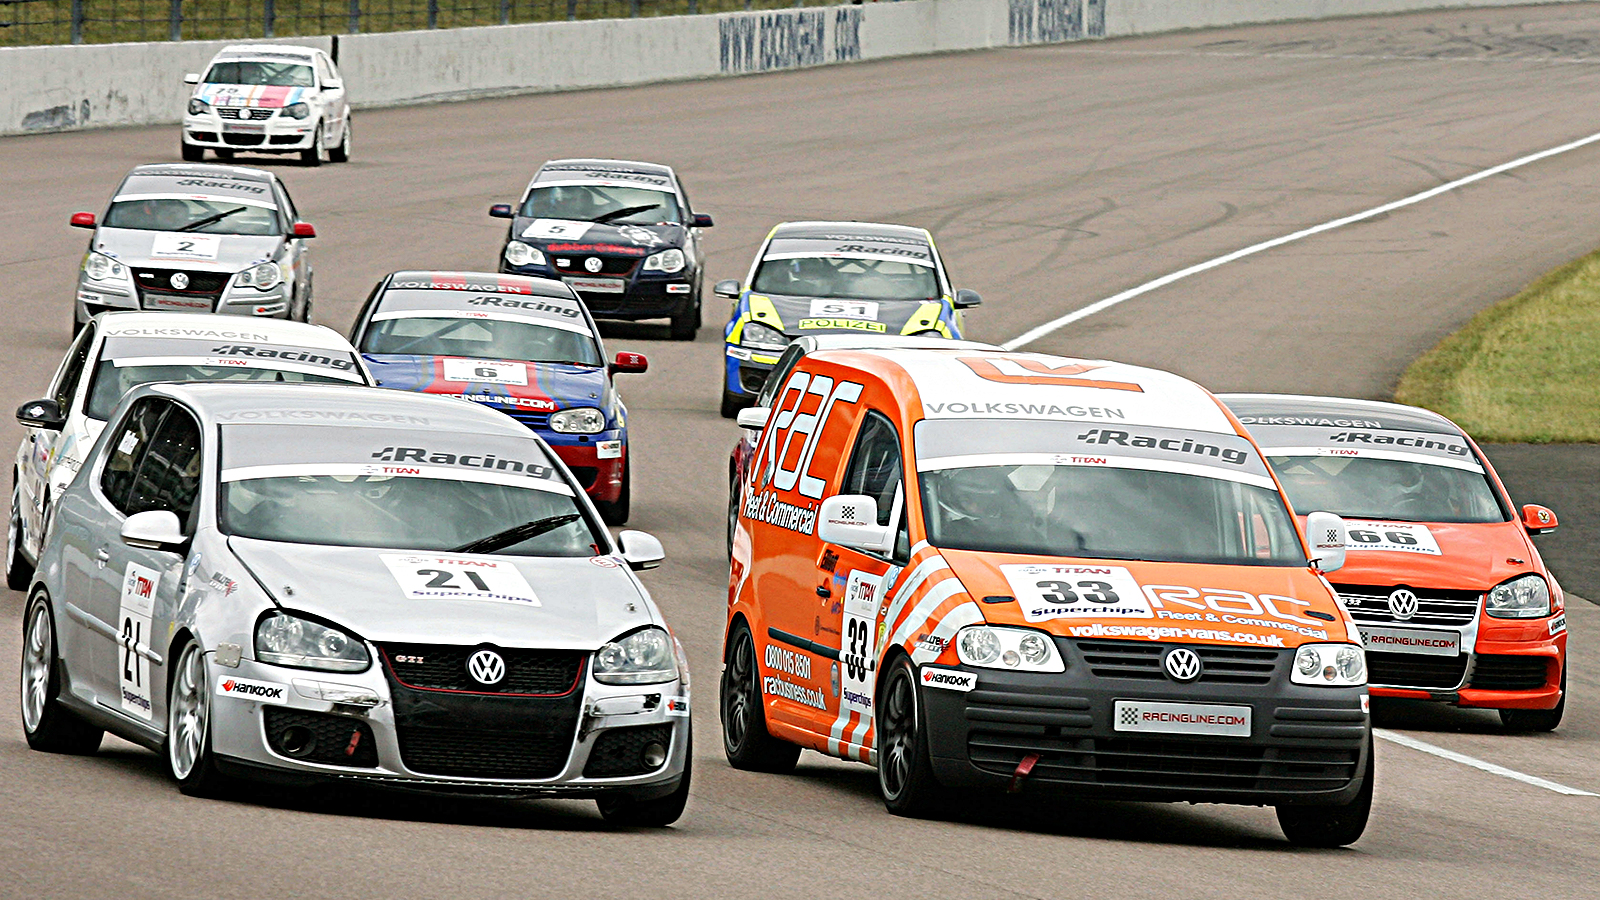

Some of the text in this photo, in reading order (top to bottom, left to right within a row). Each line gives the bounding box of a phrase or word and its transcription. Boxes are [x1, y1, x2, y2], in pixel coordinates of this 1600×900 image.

[189, 179, 265, 194] Racing
[593, 172, 667, 186] Racing
[549, 225, 567, 234] 5
[177, 241, 195, 252] 2
[846, 245, 928, 259] Racing
[393, 281, 522, 293] VOLKSWAGEN
[480, 296, 581, 318] Racing
[822, 304, 866, 315] 51
[801, 319, 884, 331] POLIZEI
[106, 328, 269, 342] VOLKSWAGEN
[225, 345, 356, 371] Racing
[474, 367, 498, 378] 6
[437, 393, 555, 411] ACINGLINE.COM
[216, 409, 431, 426] VOLKSWAGEN
[925, 402, 1126, 420] VOLKSWAGEN
[1238, 416, 1383, 429] OLKSWAGEN
[1098, 429, 1248, 465] Racing
[1348, 432, 1469, 456] Racing
[393, 447, 554, 481] Racing
[766, 490, 819, 536] Commercial
[1348, 529, 1418, 545] 66
[416, 568, 491, 592] 21
[1035, 580, 1120, 604] 33
[1156, 610, 1329, 641] Fleet & Commercial
[1069, 623, 1286, 648] volkswagen-vans.co.uk
[1371, 635, 1456, 648] RACINGLINE.COM
[395, 654, 425, 664] GTI
[1142, 712, 1245, 726] RACINGLINE.COM
